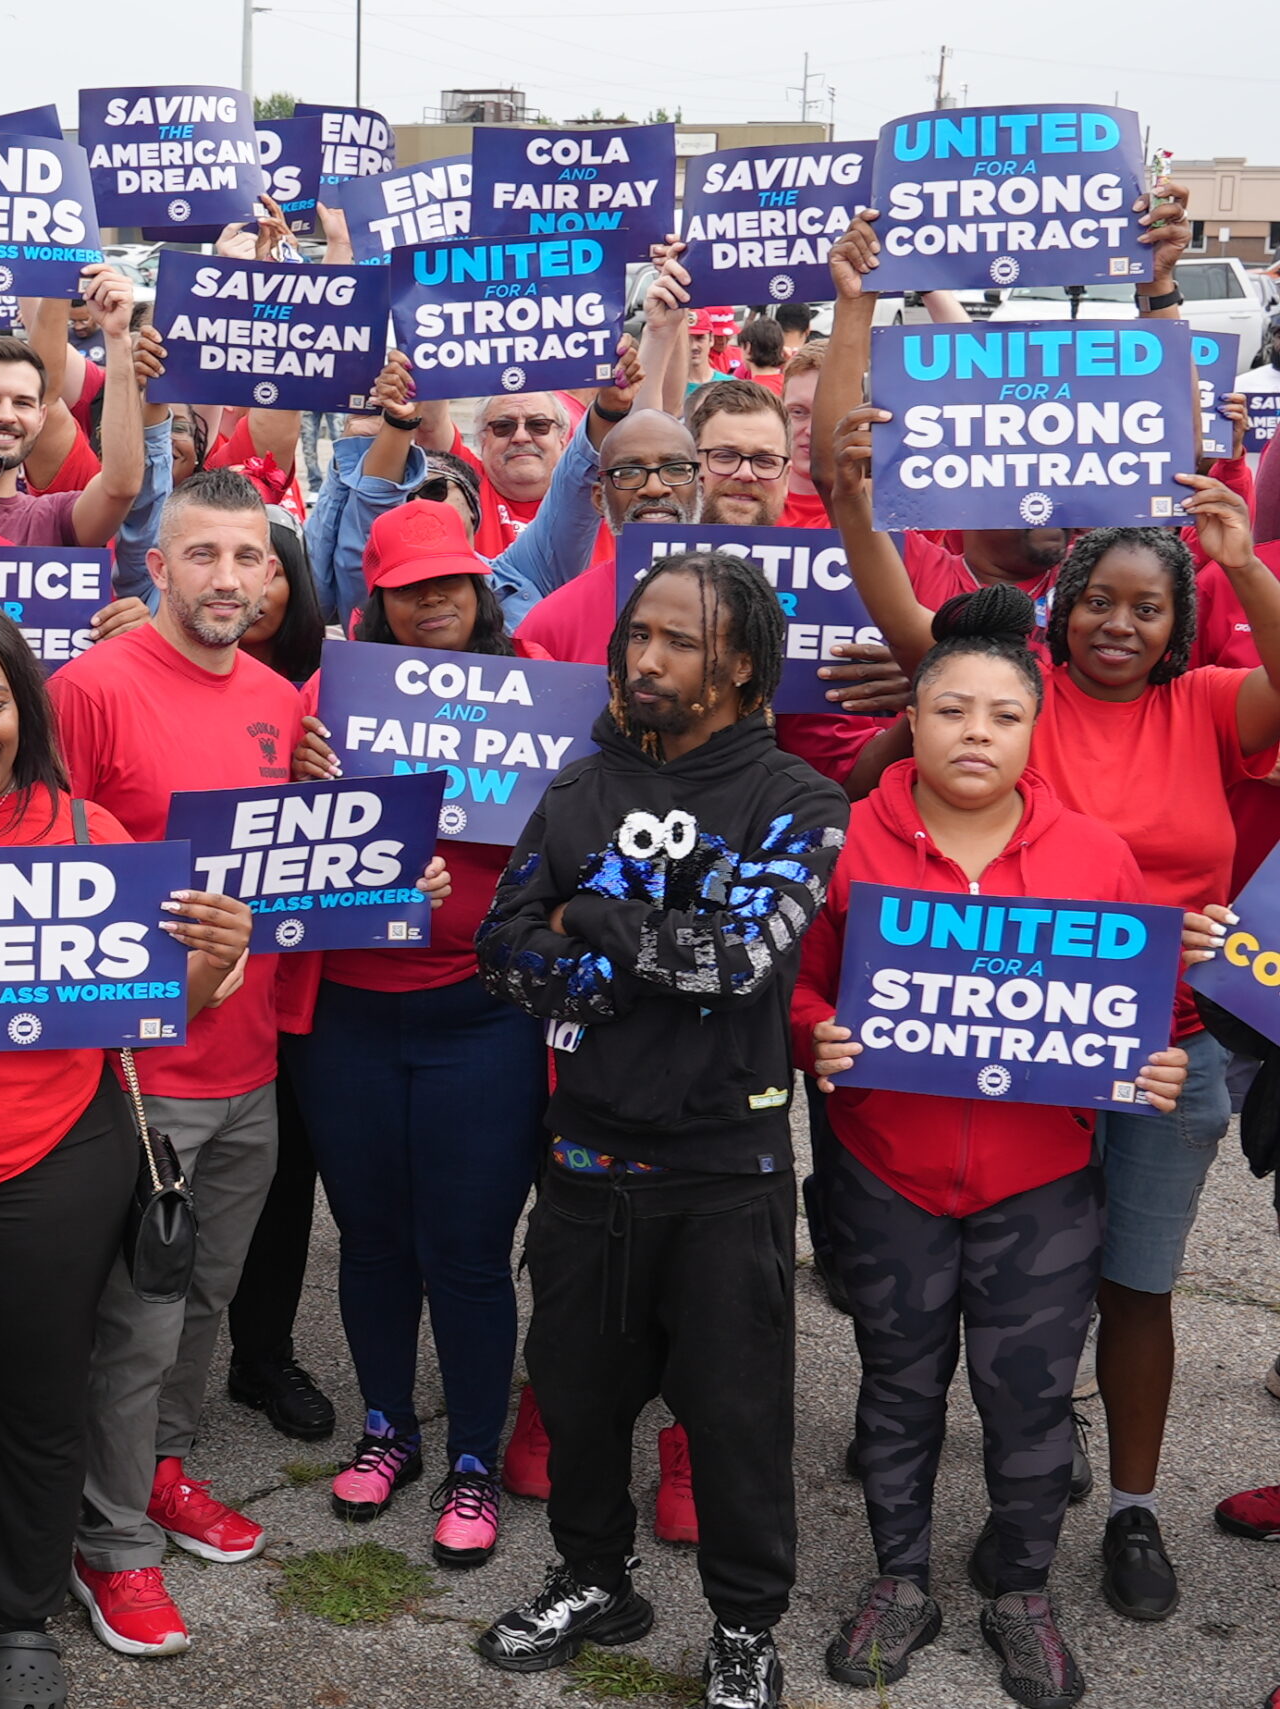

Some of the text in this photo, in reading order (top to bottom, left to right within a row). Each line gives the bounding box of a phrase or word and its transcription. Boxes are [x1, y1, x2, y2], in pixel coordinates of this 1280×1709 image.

[104, 96, 237, 126] SAVING
[159, 125, 195, 139] THE
[322, 113, 388, 150] END
[894, 113, 1120, 162] UNITED
[90, 140, 255, 168] AMERICAN
[321, 145, 393, 176] IERS
[526, 137, 630, 166] COLA
[973, 160, 1037, 176] FOR A
[117, 166, 237, 194] DREAM
[381, 163, 472, 214] END
[558, 168, 597, 181] AND
[702, 153, 863, 194] SAVING
[280, 199, 315, 213] KERS
[493, 179, 659, 209] FAIR PAY
[758, 190, 799, 207] THE
[888, 173, 1123, 221] STRONG
[368, 201, 471, 251] TIER
[529, 211, 624, 235] NOW
[885, 218, 1128, 256] CONTRACT
[23, 247, 104, 263] WORKERS
[413, 240, 605, 286] UNITED
[191, 267, 357, 307] SAVING
[484, 283, 537, 299] FOR A
[252, 303, 293, 320] THE
[415, 293, 606, 338] STRONG
[167, 315, 371, 352] AMERICAN
[413, 330, 611, 370] CONTRACT
[200, 345, 335, 378] DREAM
[903, 330, 1163, 381] UNITED
[999, 383, 1071, 401] FOR A
[903, 401, 1164, 448] STRONG
[899, 452, 1171, 489] CONTRACT
[394, 659, 534, 706] COLA
[435, 702, 487, 722] AND
[345, 715, 574, 770] FAIR PAY
[230, 791, 383, 849] END
[194, 840, 405, 898] TIERS
[247, 888, 425, 914] CLASS WORKERS
[879, 896, 1147, 960] UNITED
[971, 957, 1043, 977] FOR A
[56, 981, 180, 1003] WORKERS
[868, 968, 1138, 1029] STRONG
[860, 1016, 1140, 1070] CONTRACT
